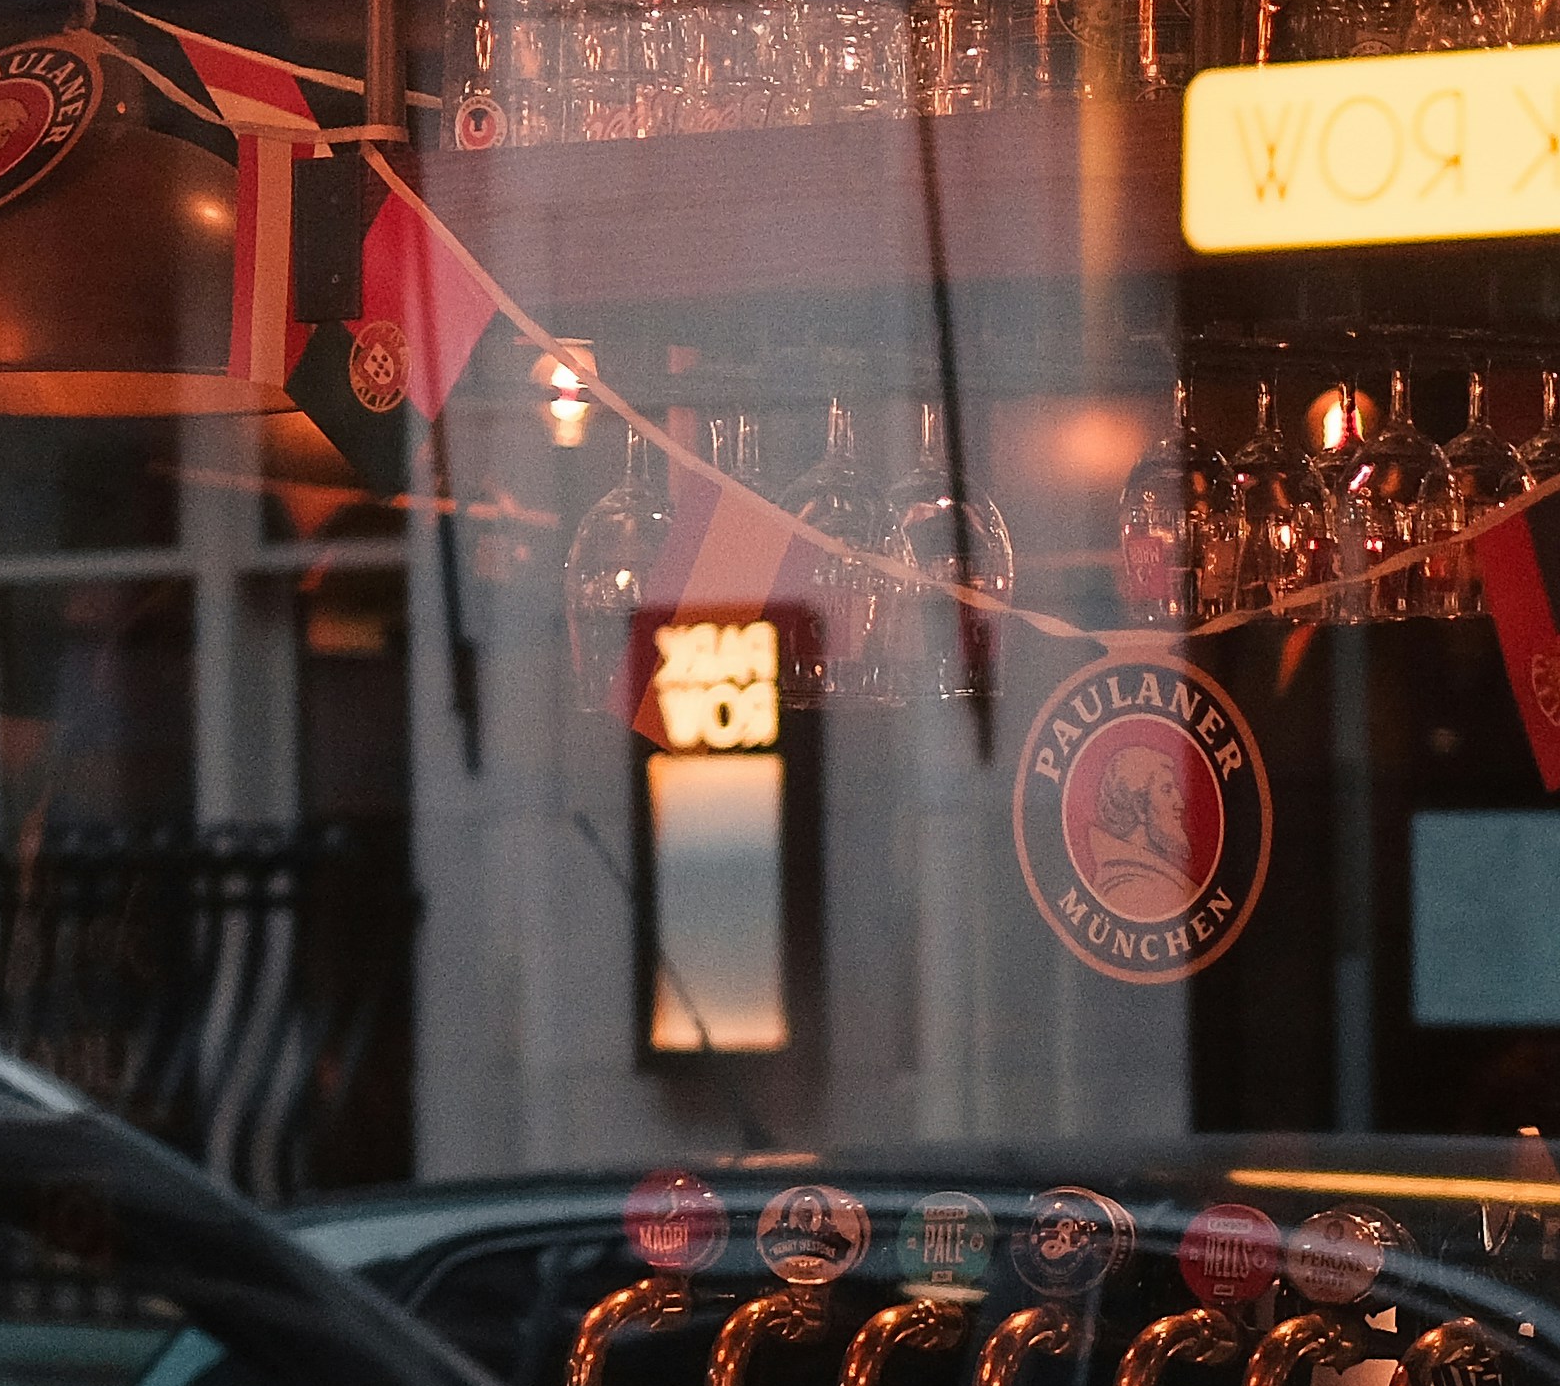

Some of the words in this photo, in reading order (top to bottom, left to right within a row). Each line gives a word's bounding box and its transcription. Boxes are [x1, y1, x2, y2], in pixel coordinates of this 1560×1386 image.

[1032, 671, 1244, 786] PAULANER
[1056, 886, 1235, 964] MÜNCHEN
[923, 1223, 967, 1264] PALE
[1204, 1234, 1252, 1279] HELLS
